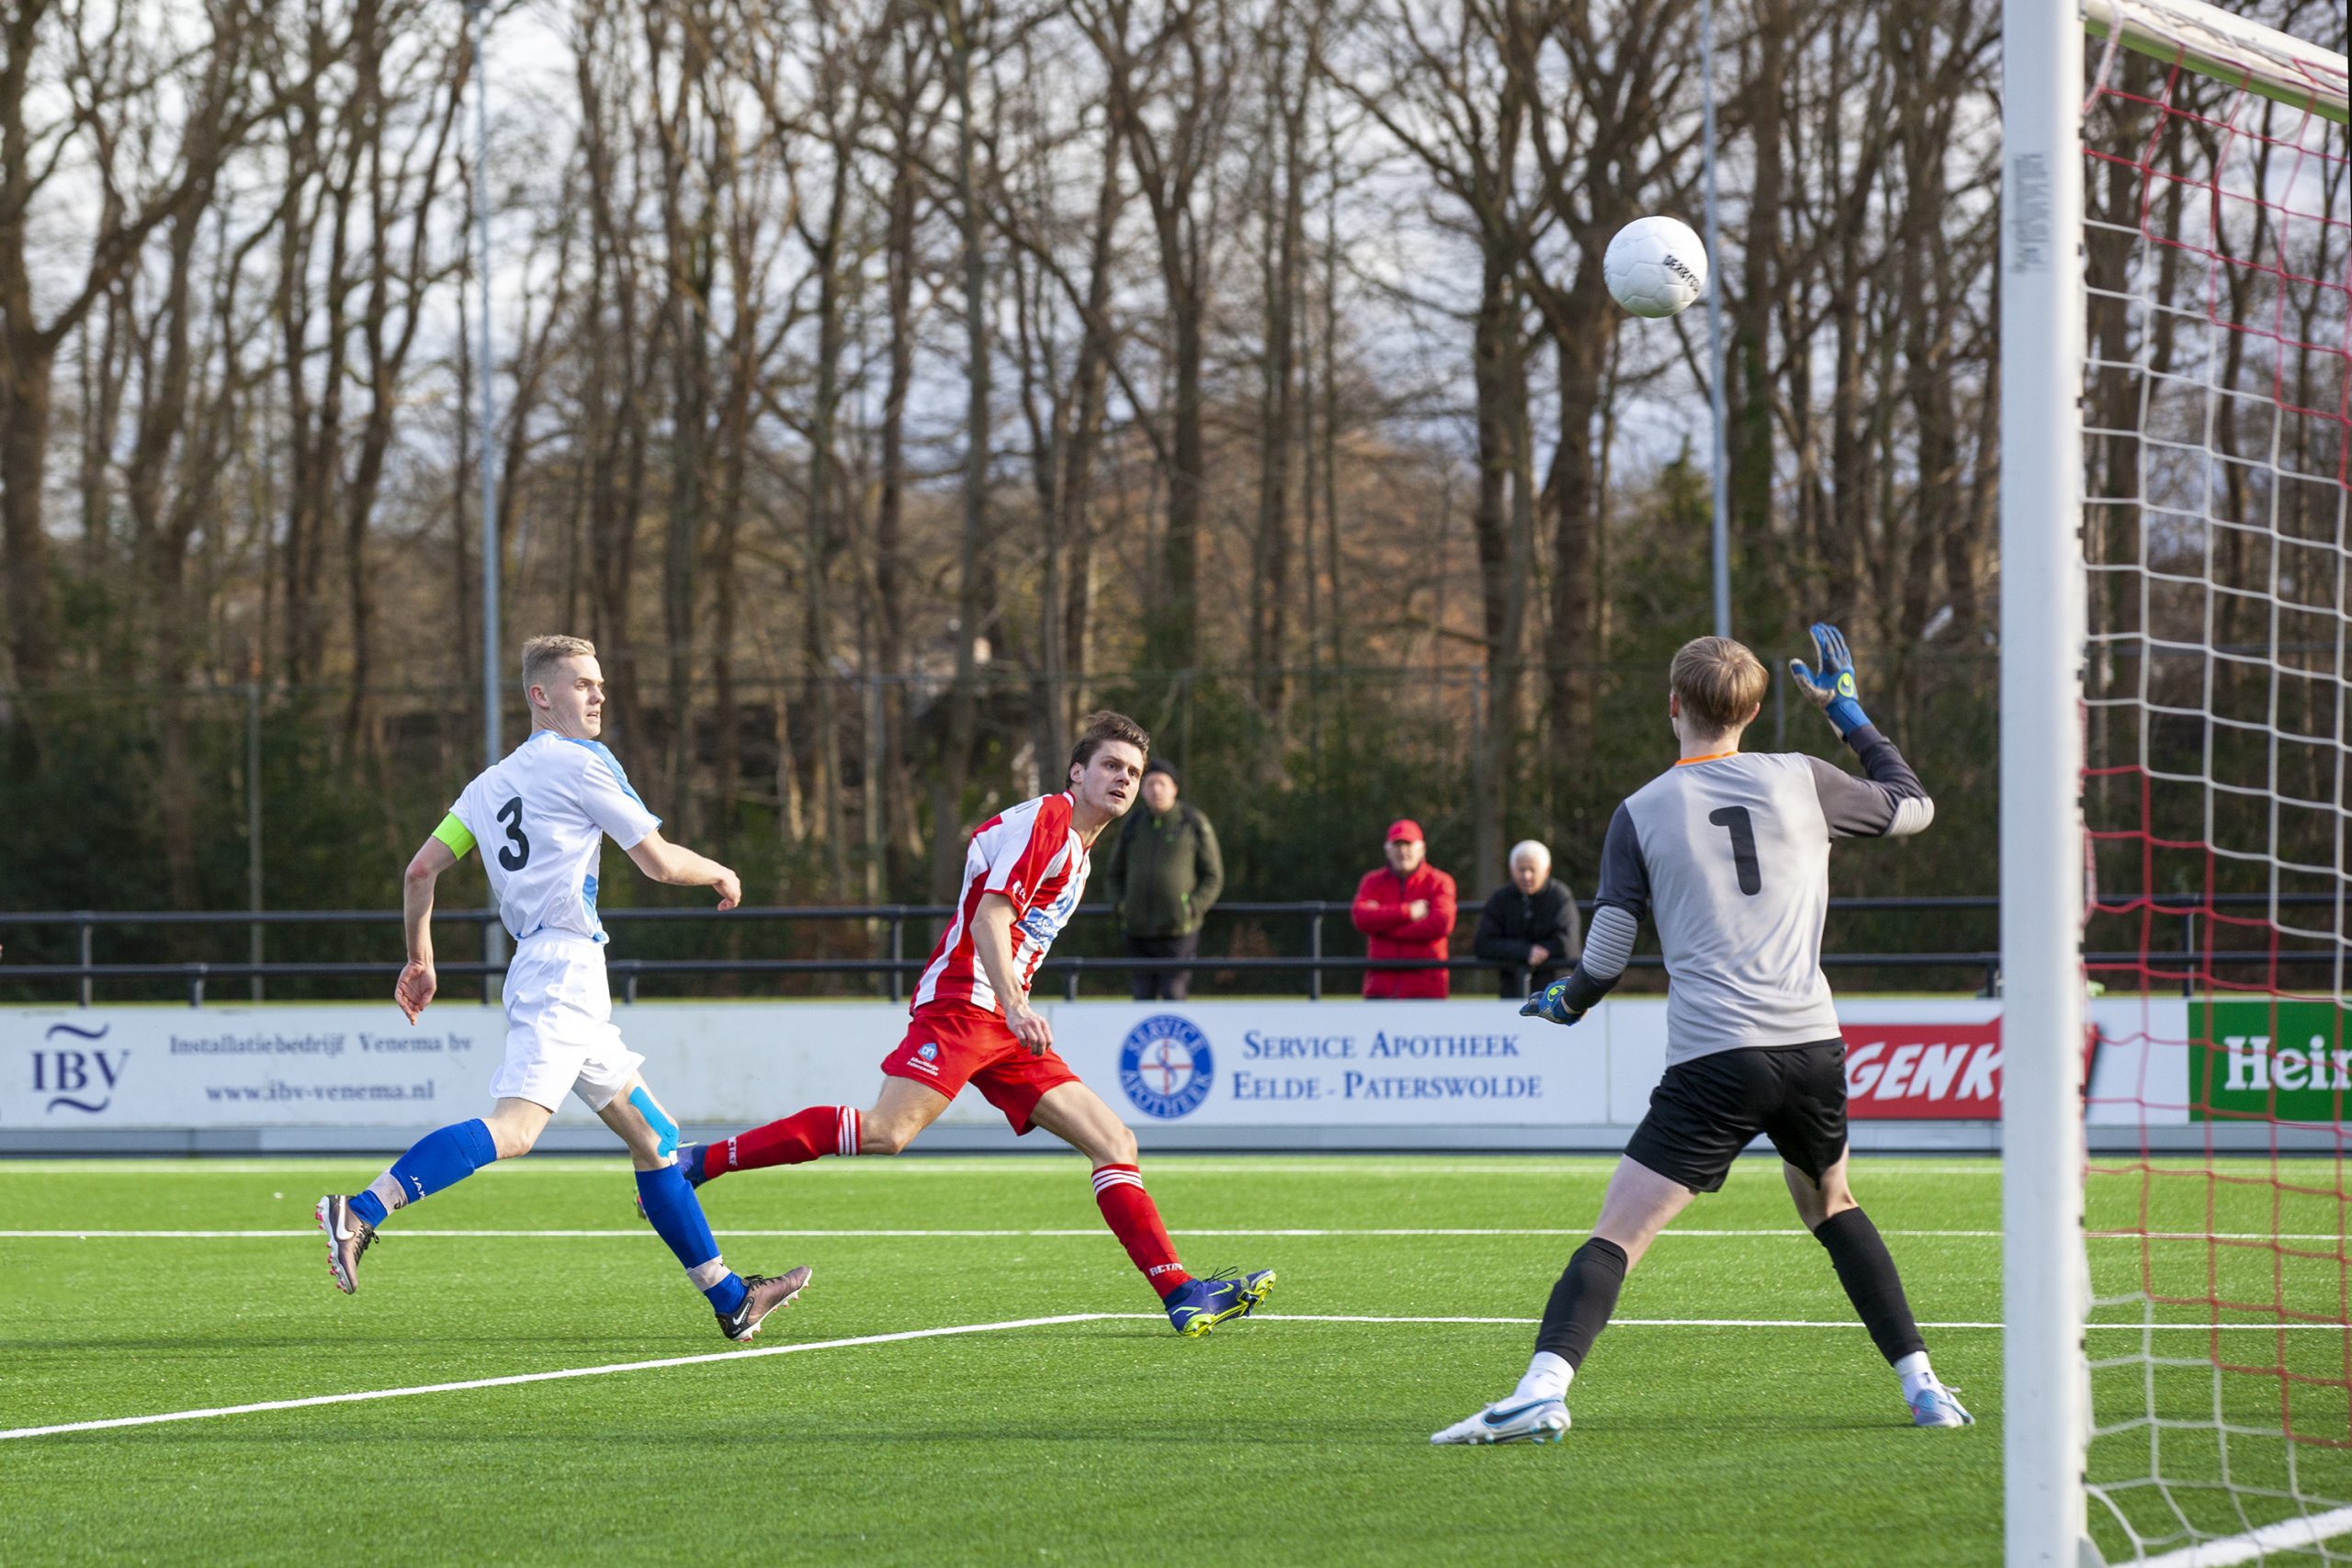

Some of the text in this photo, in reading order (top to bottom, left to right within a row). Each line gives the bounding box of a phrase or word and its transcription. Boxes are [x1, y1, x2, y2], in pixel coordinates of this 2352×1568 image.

[496, 795, 531, 872] 3
[1708, 805, 1762, 897] 1
[169, 1032, 472, 1057] Installatiebedrijf Venema bv
[1124, 1016, 1206, 1055] SERVICE
[31, 1050, 130, 1092] IBV
[205, 1078, 435, 1100] www.ibv-venema.nl
[1121, 1069, 1211, 1117] APOTHEEK
[1844, 1041, 2007, 1102] GENK
